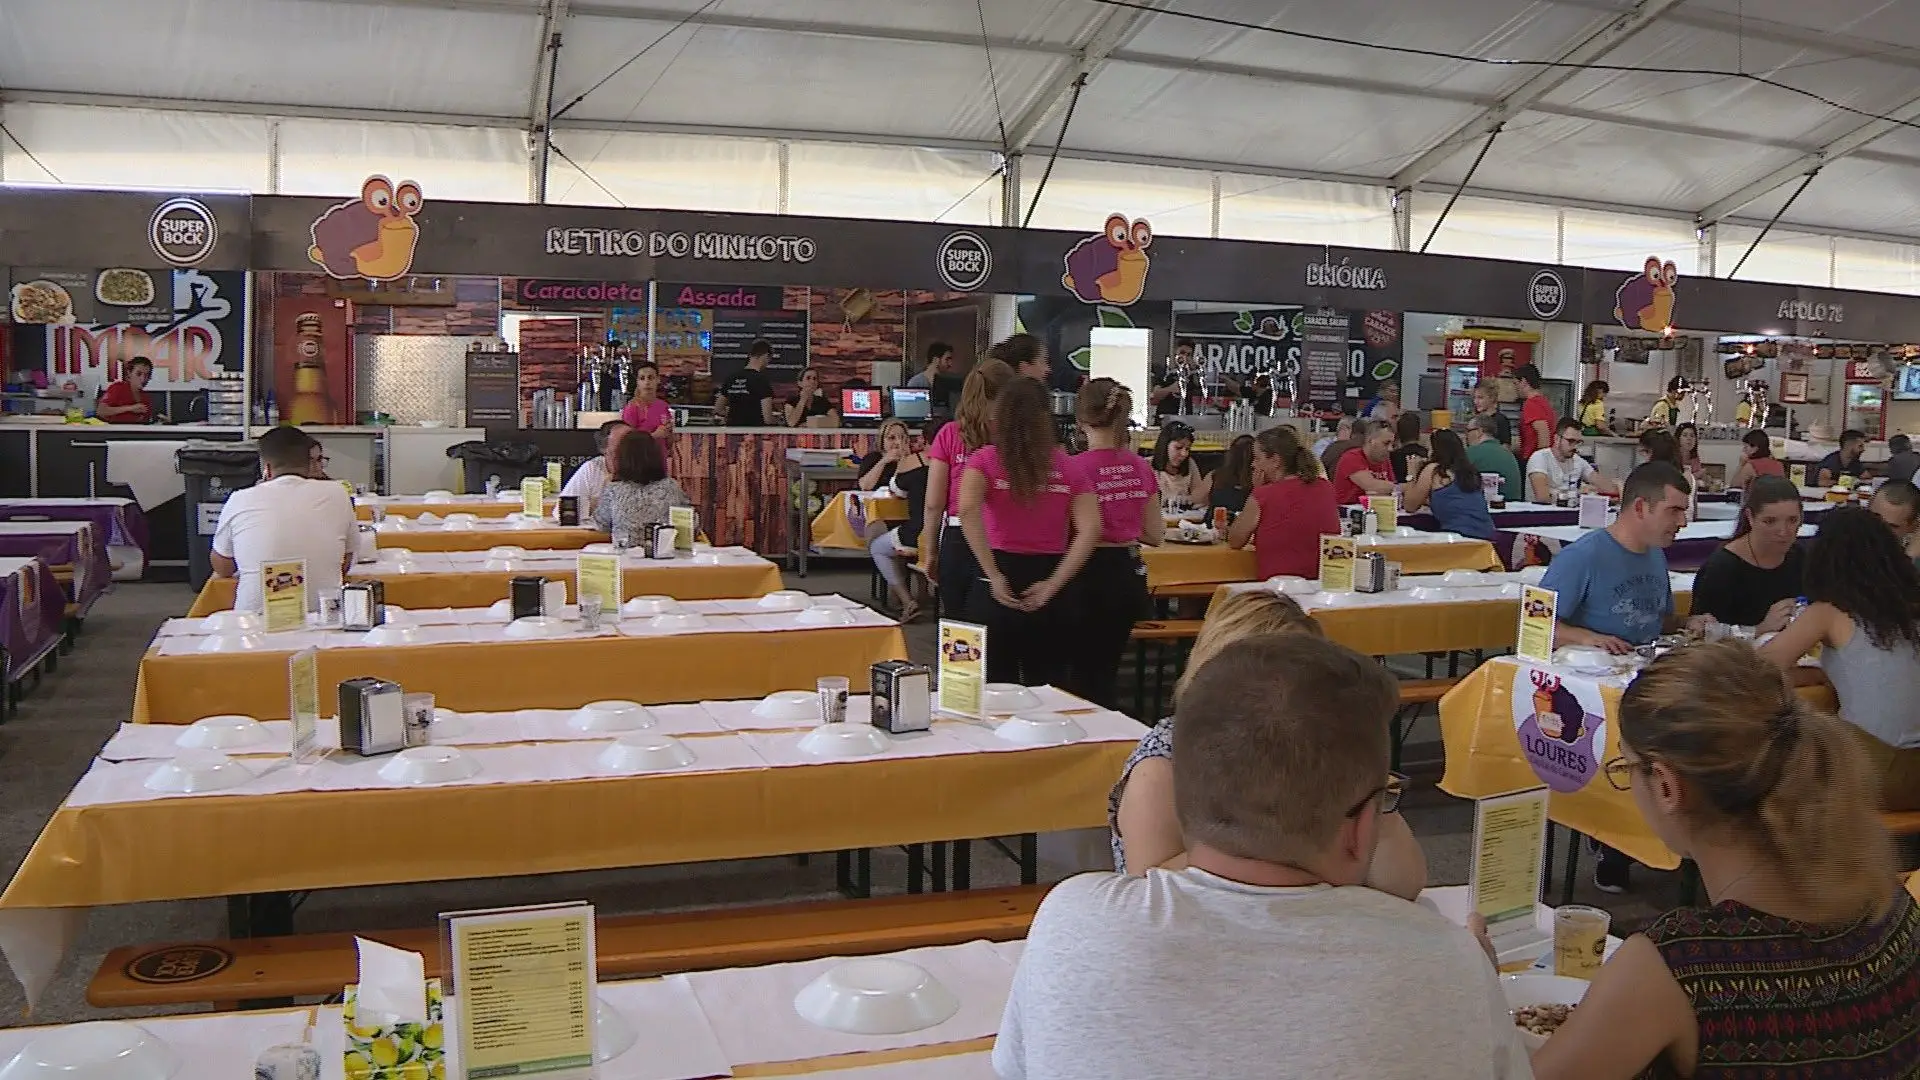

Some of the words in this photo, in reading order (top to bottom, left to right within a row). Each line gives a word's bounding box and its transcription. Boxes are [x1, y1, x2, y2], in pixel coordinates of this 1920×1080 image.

[161, 219, 205, 232] SUPER
[163, 231, 203, 245] BOCK
[545, 227, 646, 256] RETIRO
[649, 231, 692, 258] DO
[693, 232, 817, 263] MINHOTO
[947, 248, 982, 262] SUPER
[948, 260, 980, 272] BOCK
[1305, 256, 1388, 290] BRIÓNIA
[523, 279, 642, 301] Caracoleta
[677, 285, 757, 307] Assada
[1534, 283, 1560, 295] SUPER
[1535, 294, 1558, 305] BOCK
[1777, 299, 1827, 321] APOLO
[1526, 734, 1588, 774] LOURES
